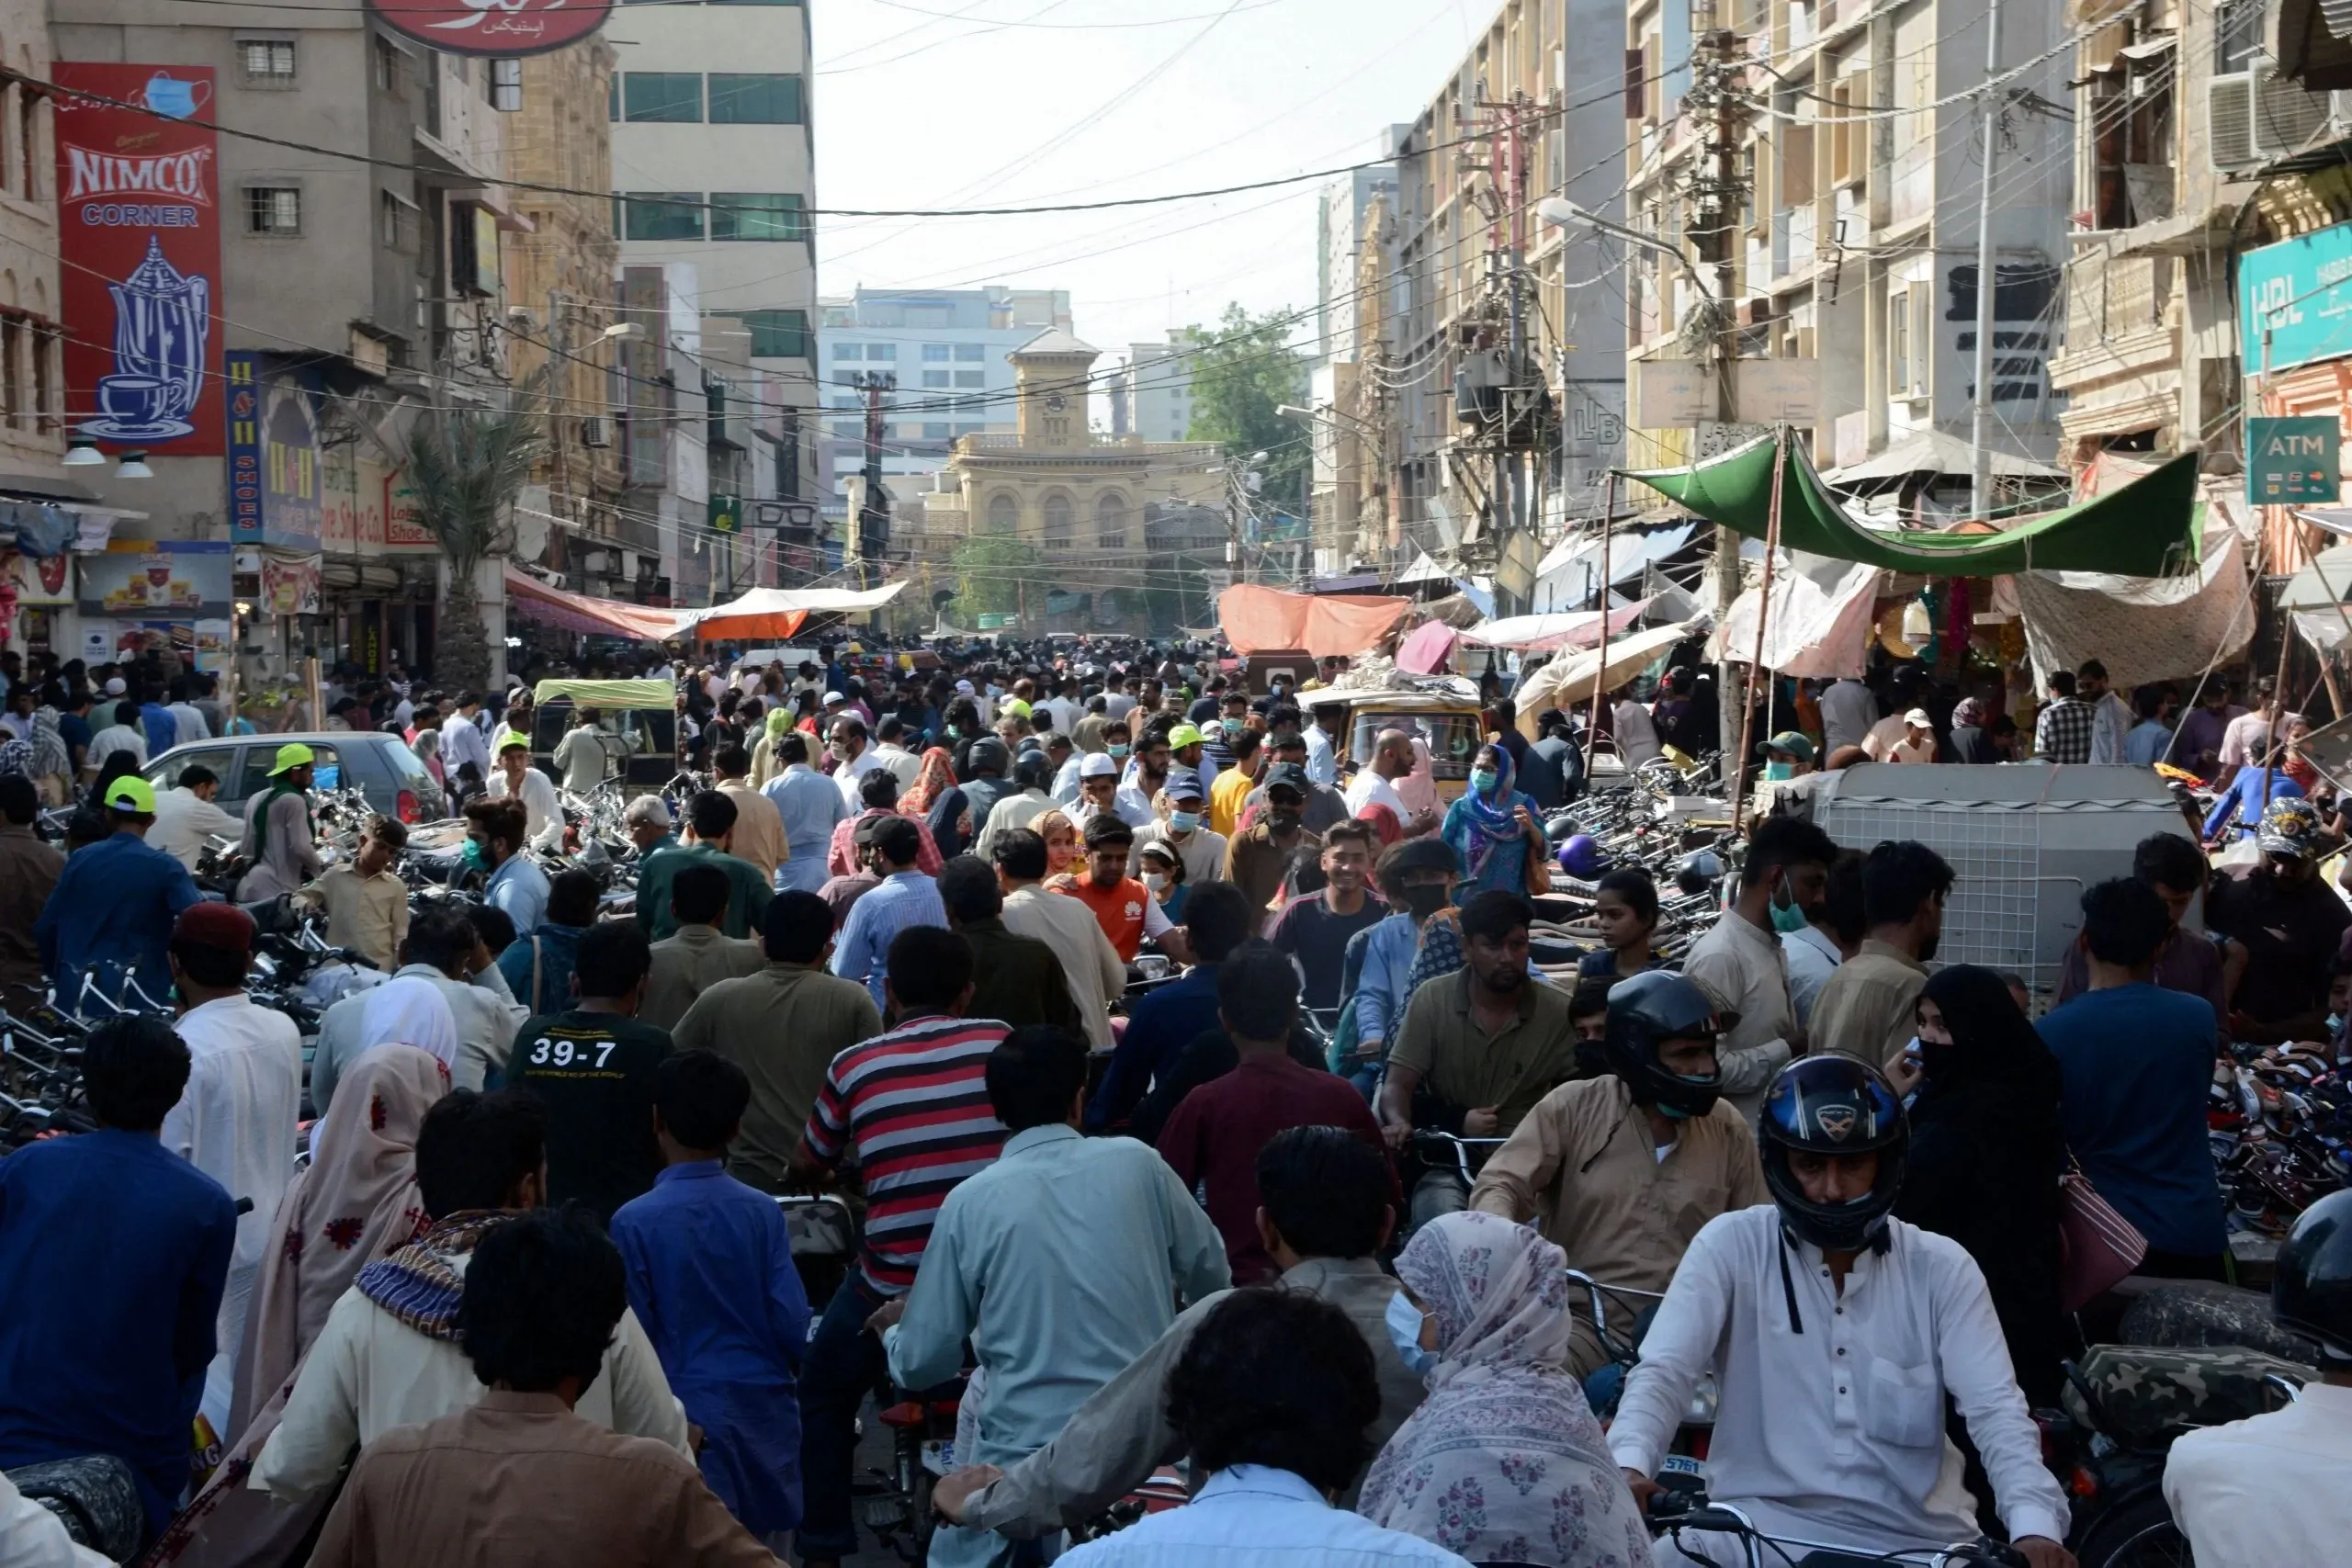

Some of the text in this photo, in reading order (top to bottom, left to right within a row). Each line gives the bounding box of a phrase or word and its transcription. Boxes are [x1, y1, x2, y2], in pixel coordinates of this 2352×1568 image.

[69, 147, 198, 198] NIMCO
[82, 203, 199, 228] CORNER
[2251, 274, 2304, 336] HBL
[2267, 434, 2324, 457] ATM
[235, 455, 258, 531] SHOES
[390, 525, 424, 540] Shoe
[529, 1037, 617, 1068] 39-7
